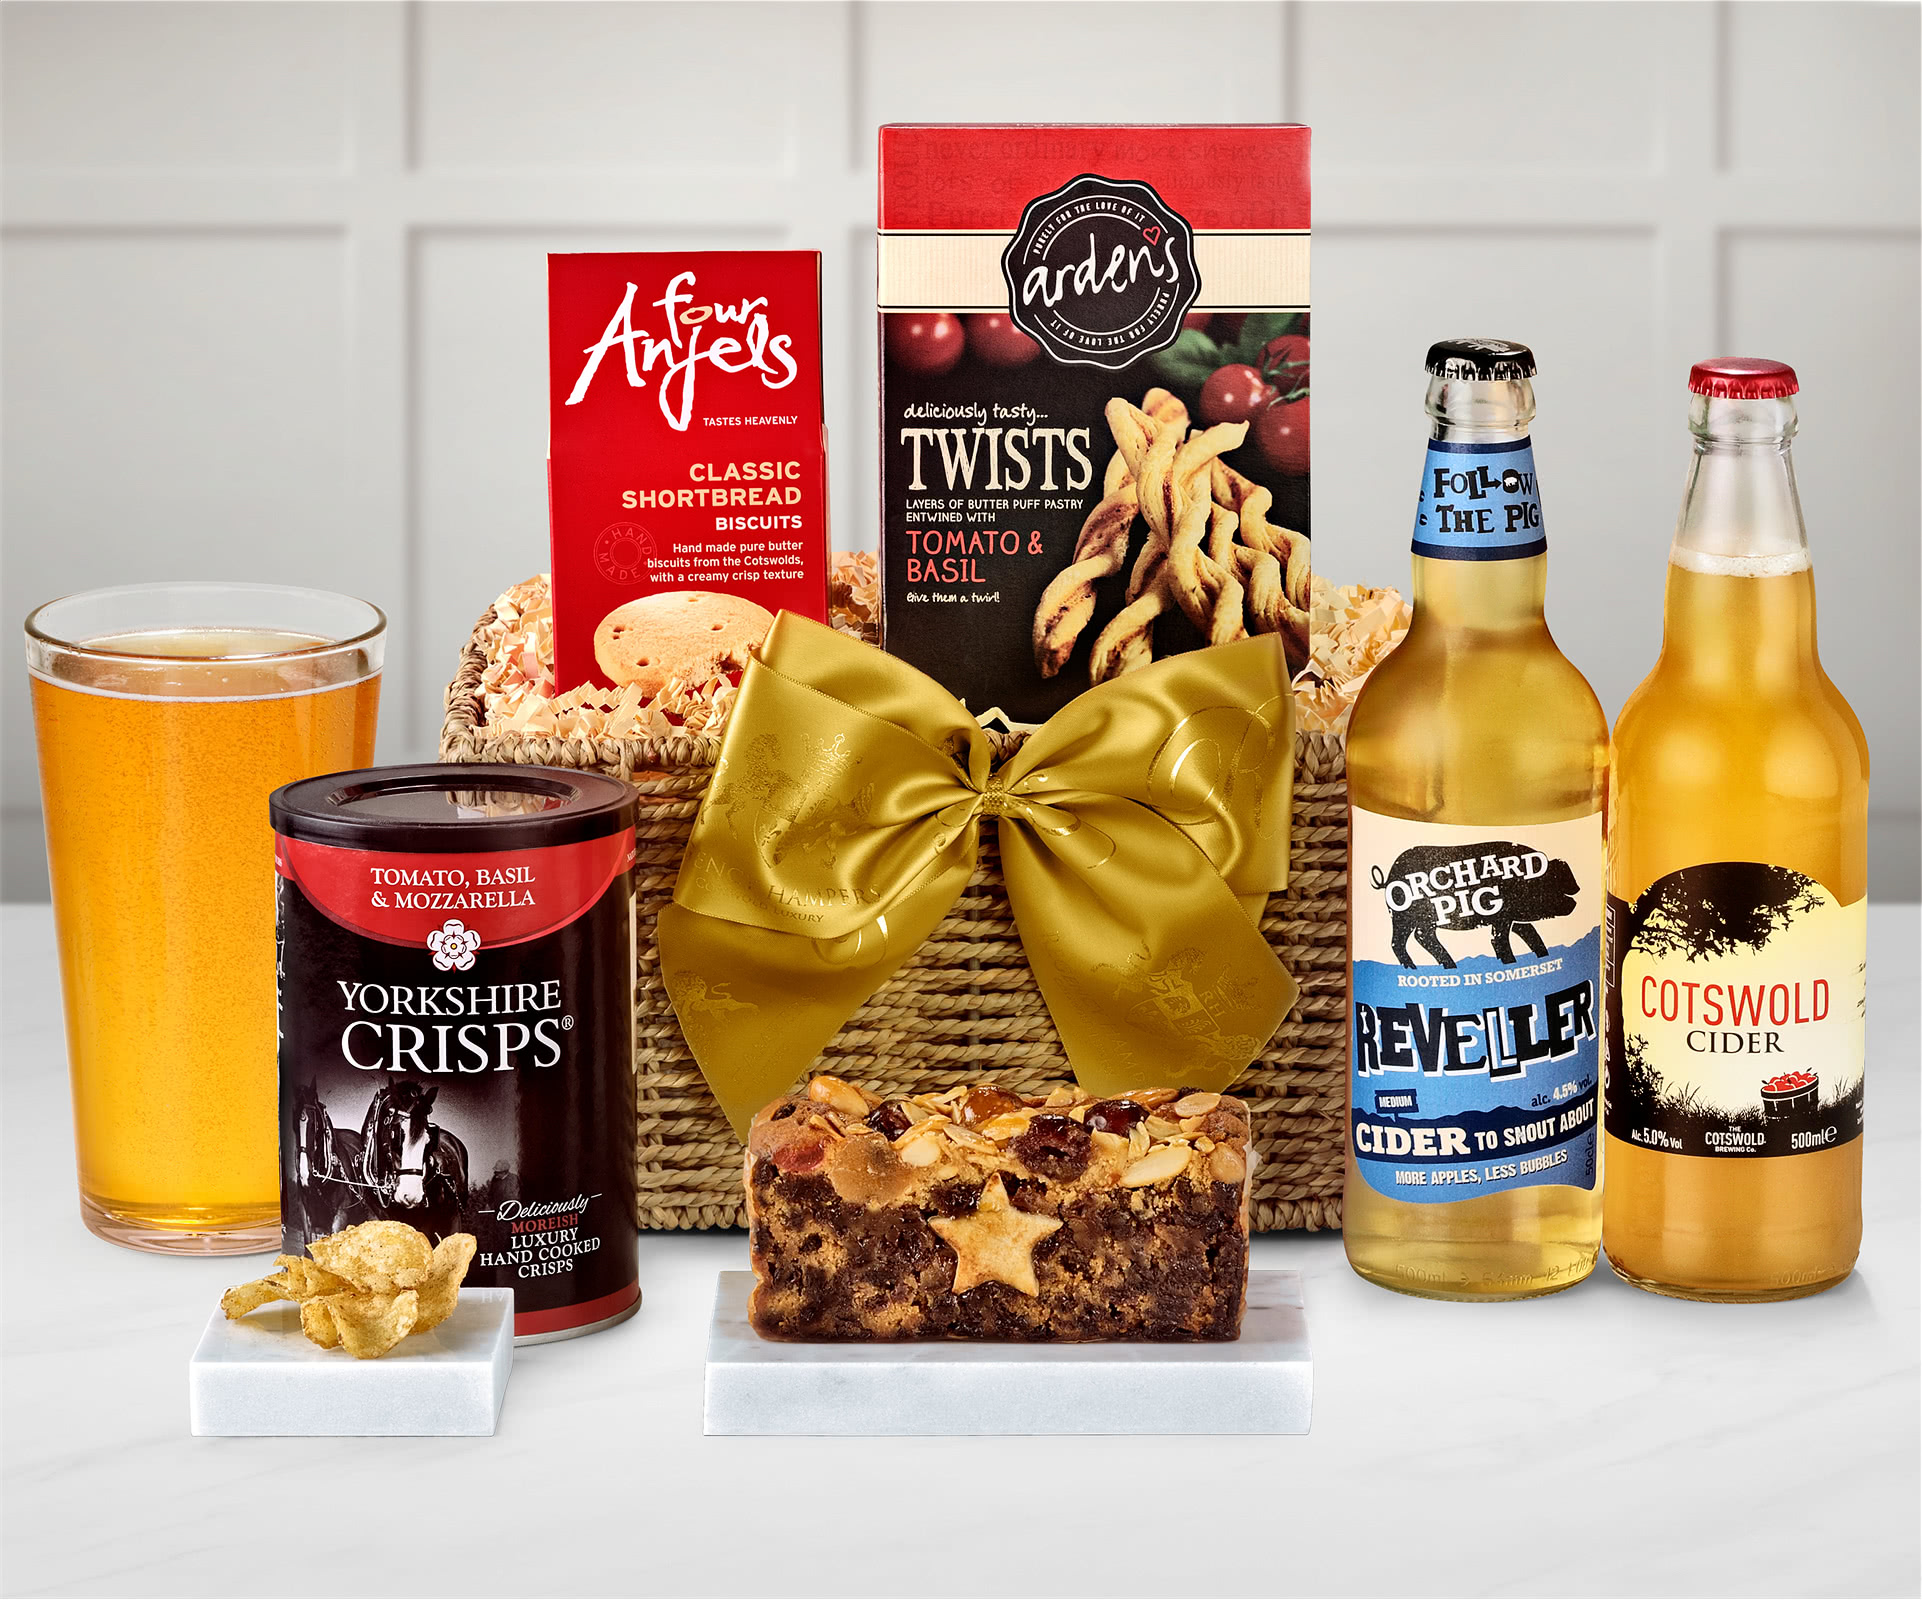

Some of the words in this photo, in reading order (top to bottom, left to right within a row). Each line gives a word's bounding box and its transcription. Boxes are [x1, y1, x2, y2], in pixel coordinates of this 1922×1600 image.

[1033, 224, 1055, 255] PURELY
[1055, 210, 1072, 224] FOR
[1074, 203, 1091, 214] THE
[1096, 202, 1117, 211] LOVE
[1121, 206, 1133, 216] OF
[1135, 213, 1146, 223] IT
[653, 271, 768, 349] four
[1148, 292, 1170, 326] PURELY
[1050, 319, 1061, 330] IT
[1063, 329, 1074, 340] OF
[1129, 325, 1146, 339] FOR
[1079, 335, 1102, 346] LOVE
[1108, 335, 1125, 346] THE
[703, 417, 741, 427] TASTES
[745, 416, 798, 426] HEAVENLY
[904, 402, 987, 426] deliciously
[993, 403, 1048, 426] tasty...
[901, 427, 1093, 491] TWISTS
[690, 461, 800, 482] CLASSIC
[1434, 465, 1534, 500] FOLLOW
[622, 487, 801, 509] SHORTBREAD
[906, 499, 945, 510] LAYERS
[949, 499, 964, 509] OF
[968, 499, 1009, 510] BUTTER
[1013, 499, 1040, 510] PUFF
[1044, 499, 1084, 510] PASTRY
[716, 515, 803, 531] BISCUITS
[906, 512, 962, 523] ENTWINED
[966, 512, 995, 523] WITH
[1436, 504, 1495, 534] THE
[1504, 501, 1540, 533] PIG
[673, 543, 702, 554] Hand
[706, 542, 736, 553] made
[739, 543, 765, 556] pure
[768, 541, 803, 551] butter
[906, 530, 1020, 555] TOMATO
[1027, 530, 1044, 555] &
[647, 557, 690, 569] biscuits
[693, 557, 720, 568] from
[722, 556, 741, 567] the
[744, 555, 804, 567] Cotswolds,
[907, 558, 986, 583] BASIL
[650, 572, 674, 583] with
[678, 574, 684, 582] a
[687, 573, 728, 583] creamy
[732, 570, 760, 582] crisp
[763, 570, 804, 580] texture
[906, 592, 929, 603] Give
[932, 592, 957, 603] them
[971, 592, 1000, 603] twirl!
[370, 867, 471, 890] TOMATO,
[477, 866, 536, 885] BASIL
[1385, 851, 1549, 912] ORCHARD
[371, 890, 389, 908] &
[395, 889, 536, 910] MOZZARELLA
[767, 884, 882, 907] HAMPERS
[1430, 885, 1504, 926] PIG
[773, 908, 824, 923] LUXURY
[1398, 974, 1461, 988] ROOTED
[1464, 972, 1482, 986] IN
[1485, 958, 1563, 984] SOMERSET
[337, 979, 562, 1017] YORKSHIRE
[1641, 975, 1829, 1027] COTSWOLD
[1355, 979, 1597, 1083] REVELLER
[1686, 1030, 1785, 1054] CIDER
[1379, 1095, 1412, 1108] MEDIUM
[1531, 1094, 1551, 1107] alc.
[1552, 1081, 1578, 1100] 4.5%
[1579, 1077, 1592, 1090] vol.
[1356, 1122, 1471, 1157] CIDER
[1475, 1130, 1498, 1151] TO
[1504, 1117, 1556, 1147] SNOUT
[1560, 1098, 1594, 1134] ABOUT
[1643, 1127, 1669, 1147] 5.0%
[1670, 1137, 1683, 1149] Vol
[1705, 1131, 1765, 1146] COTSWOLD
[1396, 1170, 1427, 1186] MORE
[1431, 1169, 1482, 1185] APPLES,
[1485, 1163, 1516, 1180] LESS
[1520, 1149, 1568, 1176] BUBBLES
[497, 1193, 590, 1221] Deliciously
[511, 1213, 579, 1234] MOREISH
[510, 1227, 579, 1250] LUXURY
[480, 1250, 533, 1267] HAND
[538, 1237, 601, 1261] COOKED
[518, 1259, 574, 1278] CRISPS
